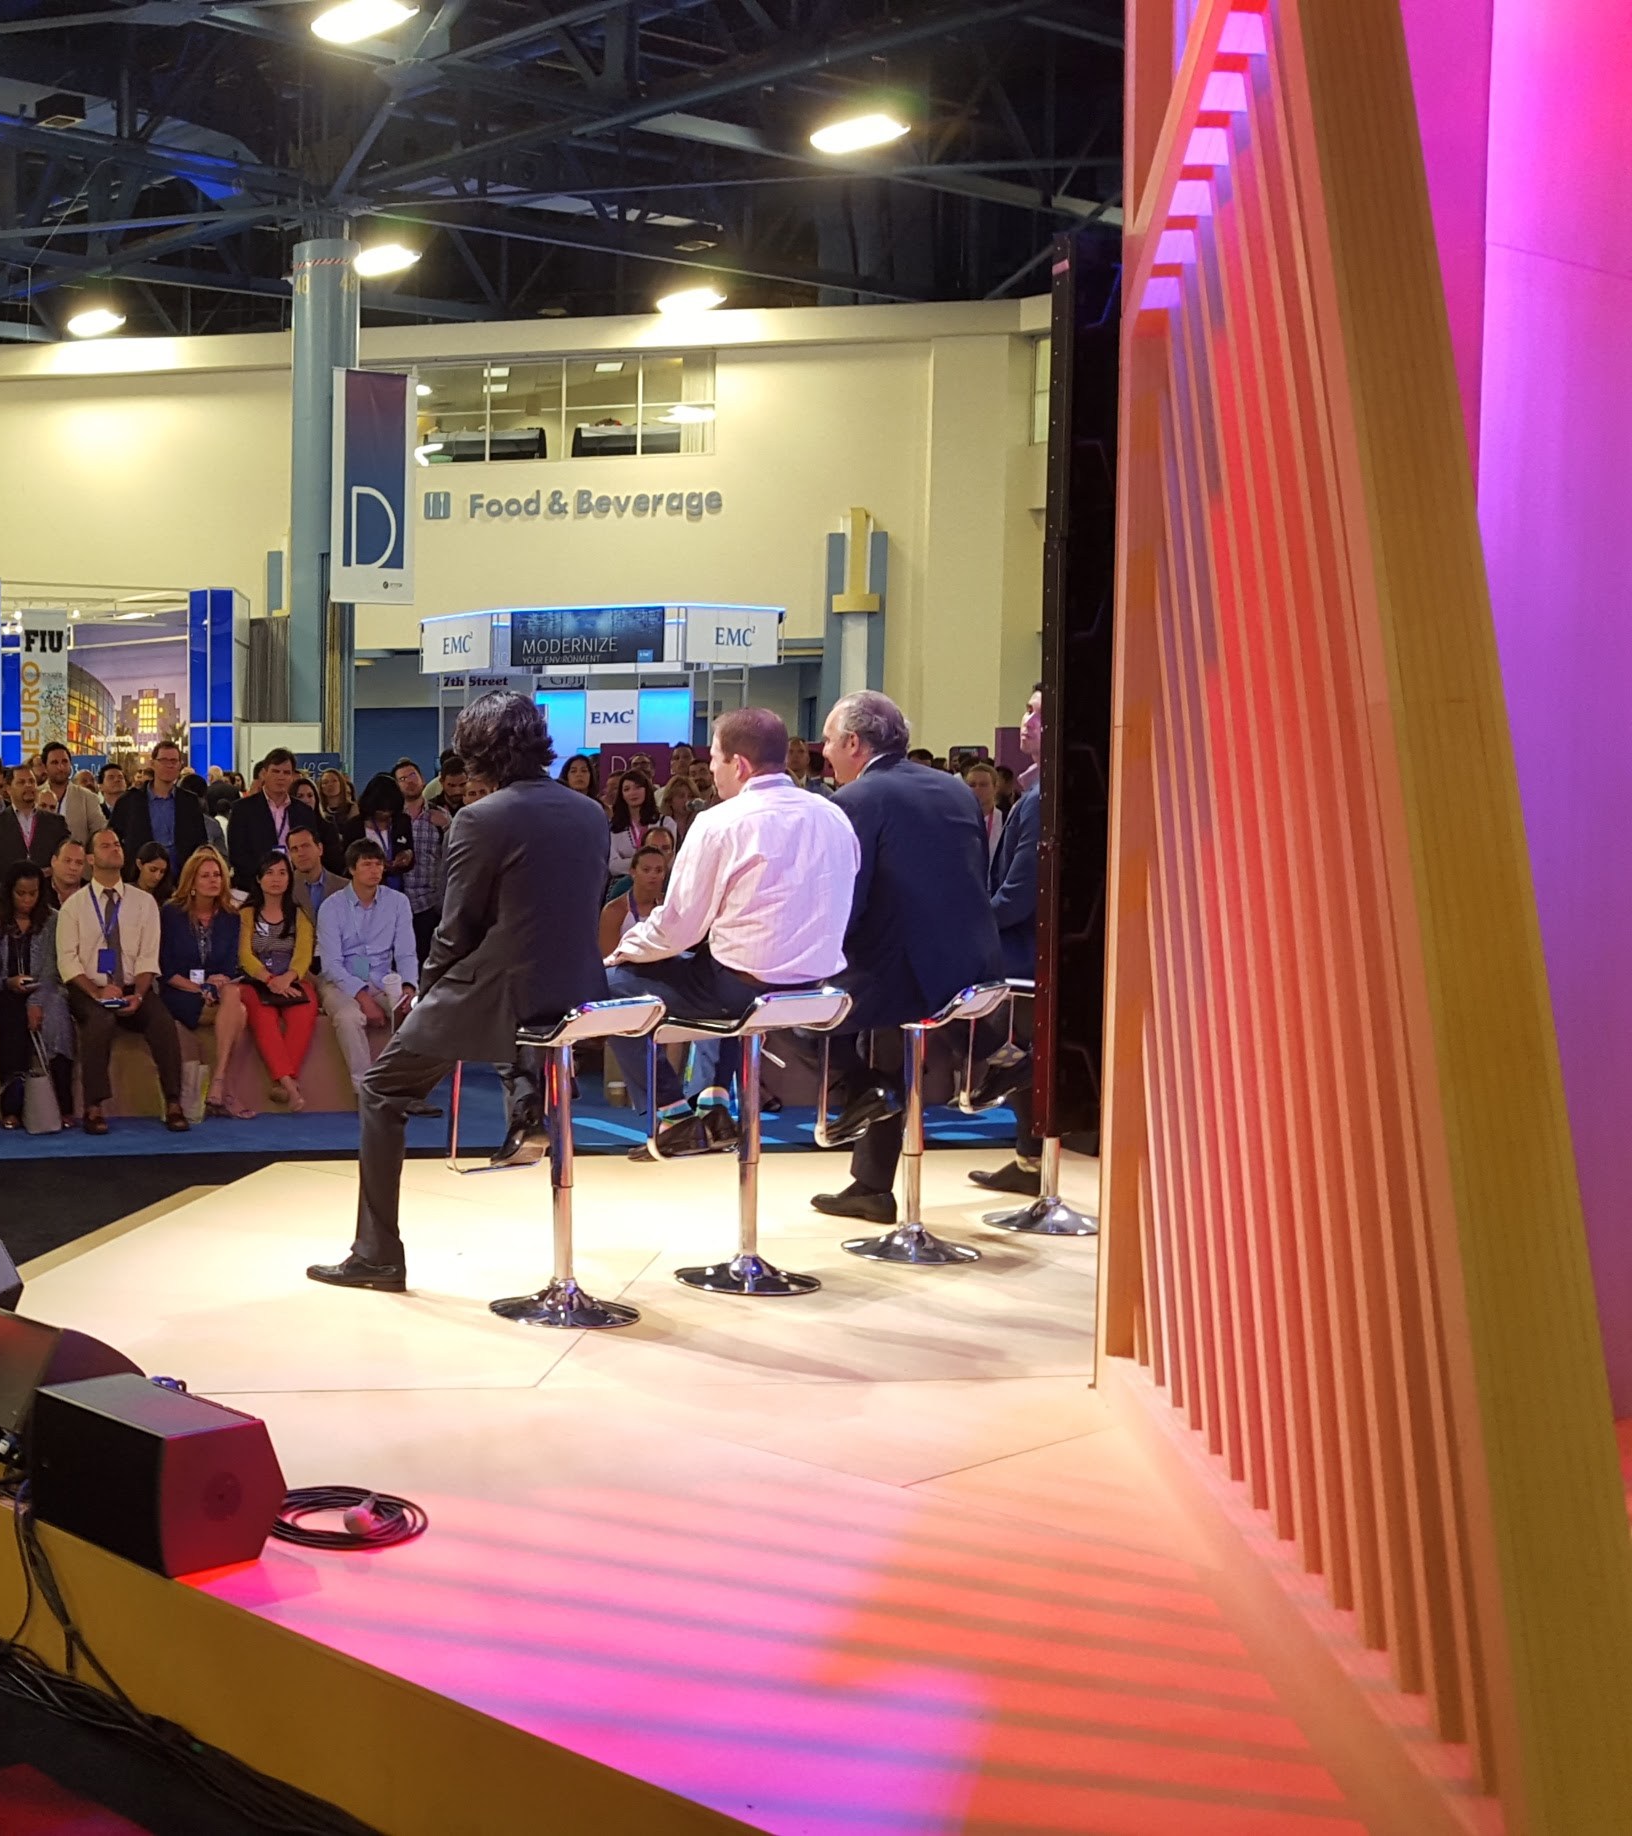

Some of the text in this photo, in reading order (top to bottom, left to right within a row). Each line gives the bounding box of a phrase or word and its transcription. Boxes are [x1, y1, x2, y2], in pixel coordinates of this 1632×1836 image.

[469, 489, 723, 523] Food & Beverage
[24, 629, 64, 653] FIU
[522, 636, 618, 655] MODERNIZE
[522, 654, 601, 665] YOUR ENVIRONMENT
[468, 676, 509, 687] Street
